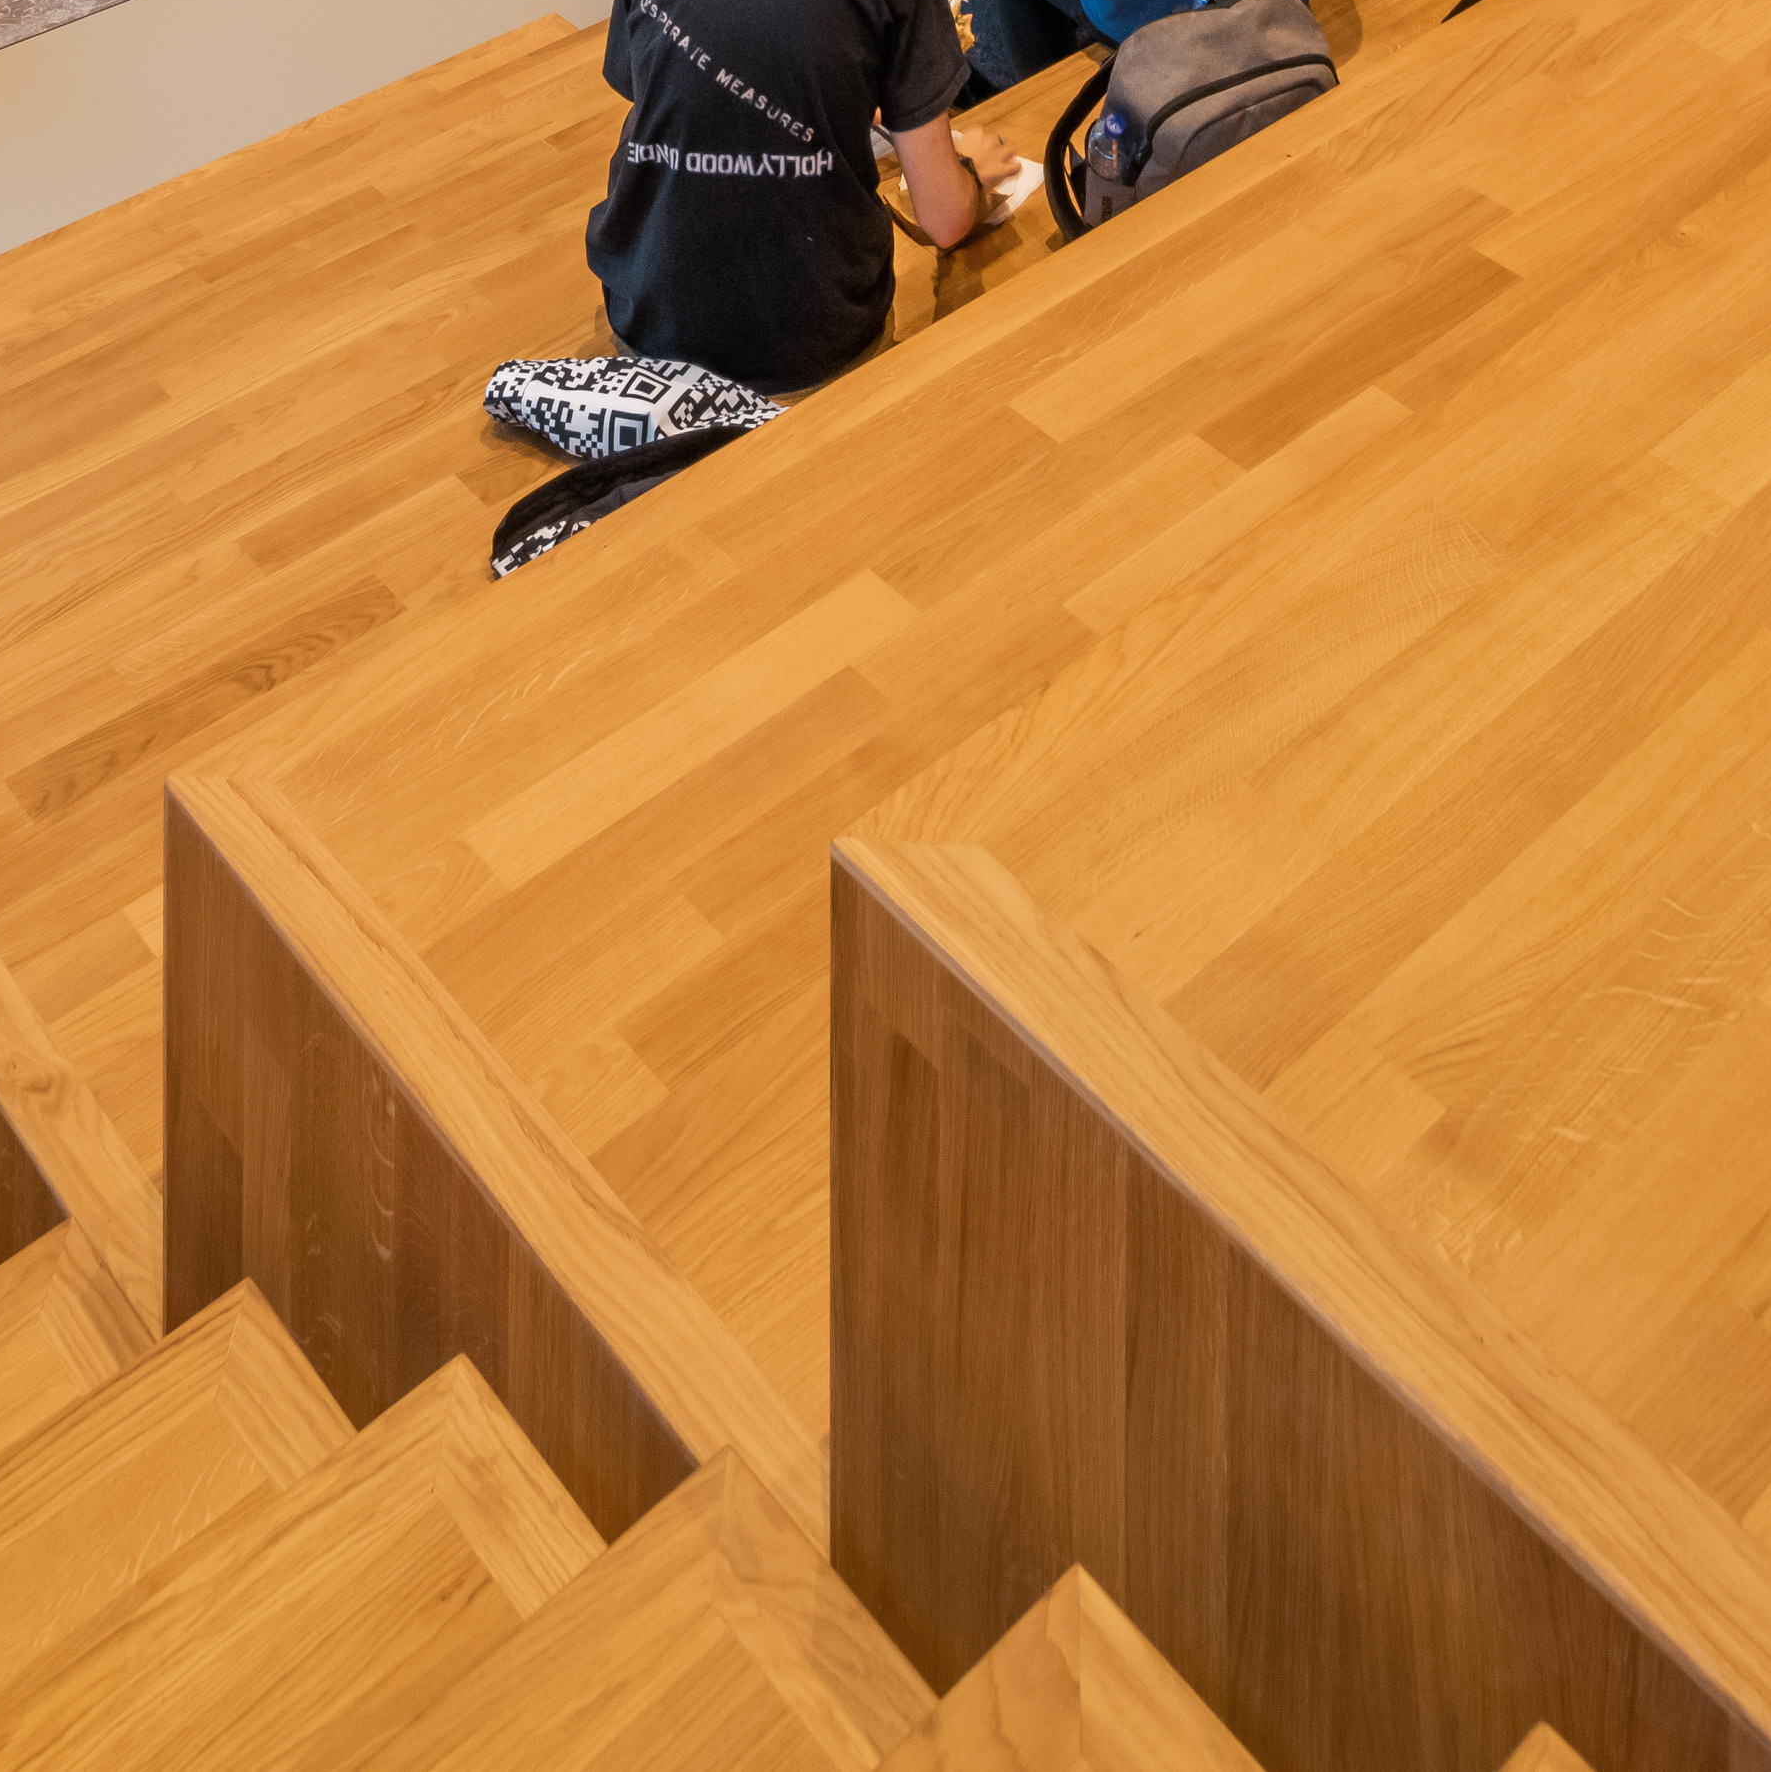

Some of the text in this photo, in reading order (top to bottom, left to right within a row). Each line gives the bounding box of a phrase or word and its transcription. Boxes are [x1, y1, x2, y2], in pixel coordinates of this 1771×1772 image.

[715, 68, 815, 143] MEASURES
[628, 141, 833, 178] HOLLYWOOD UNDE
